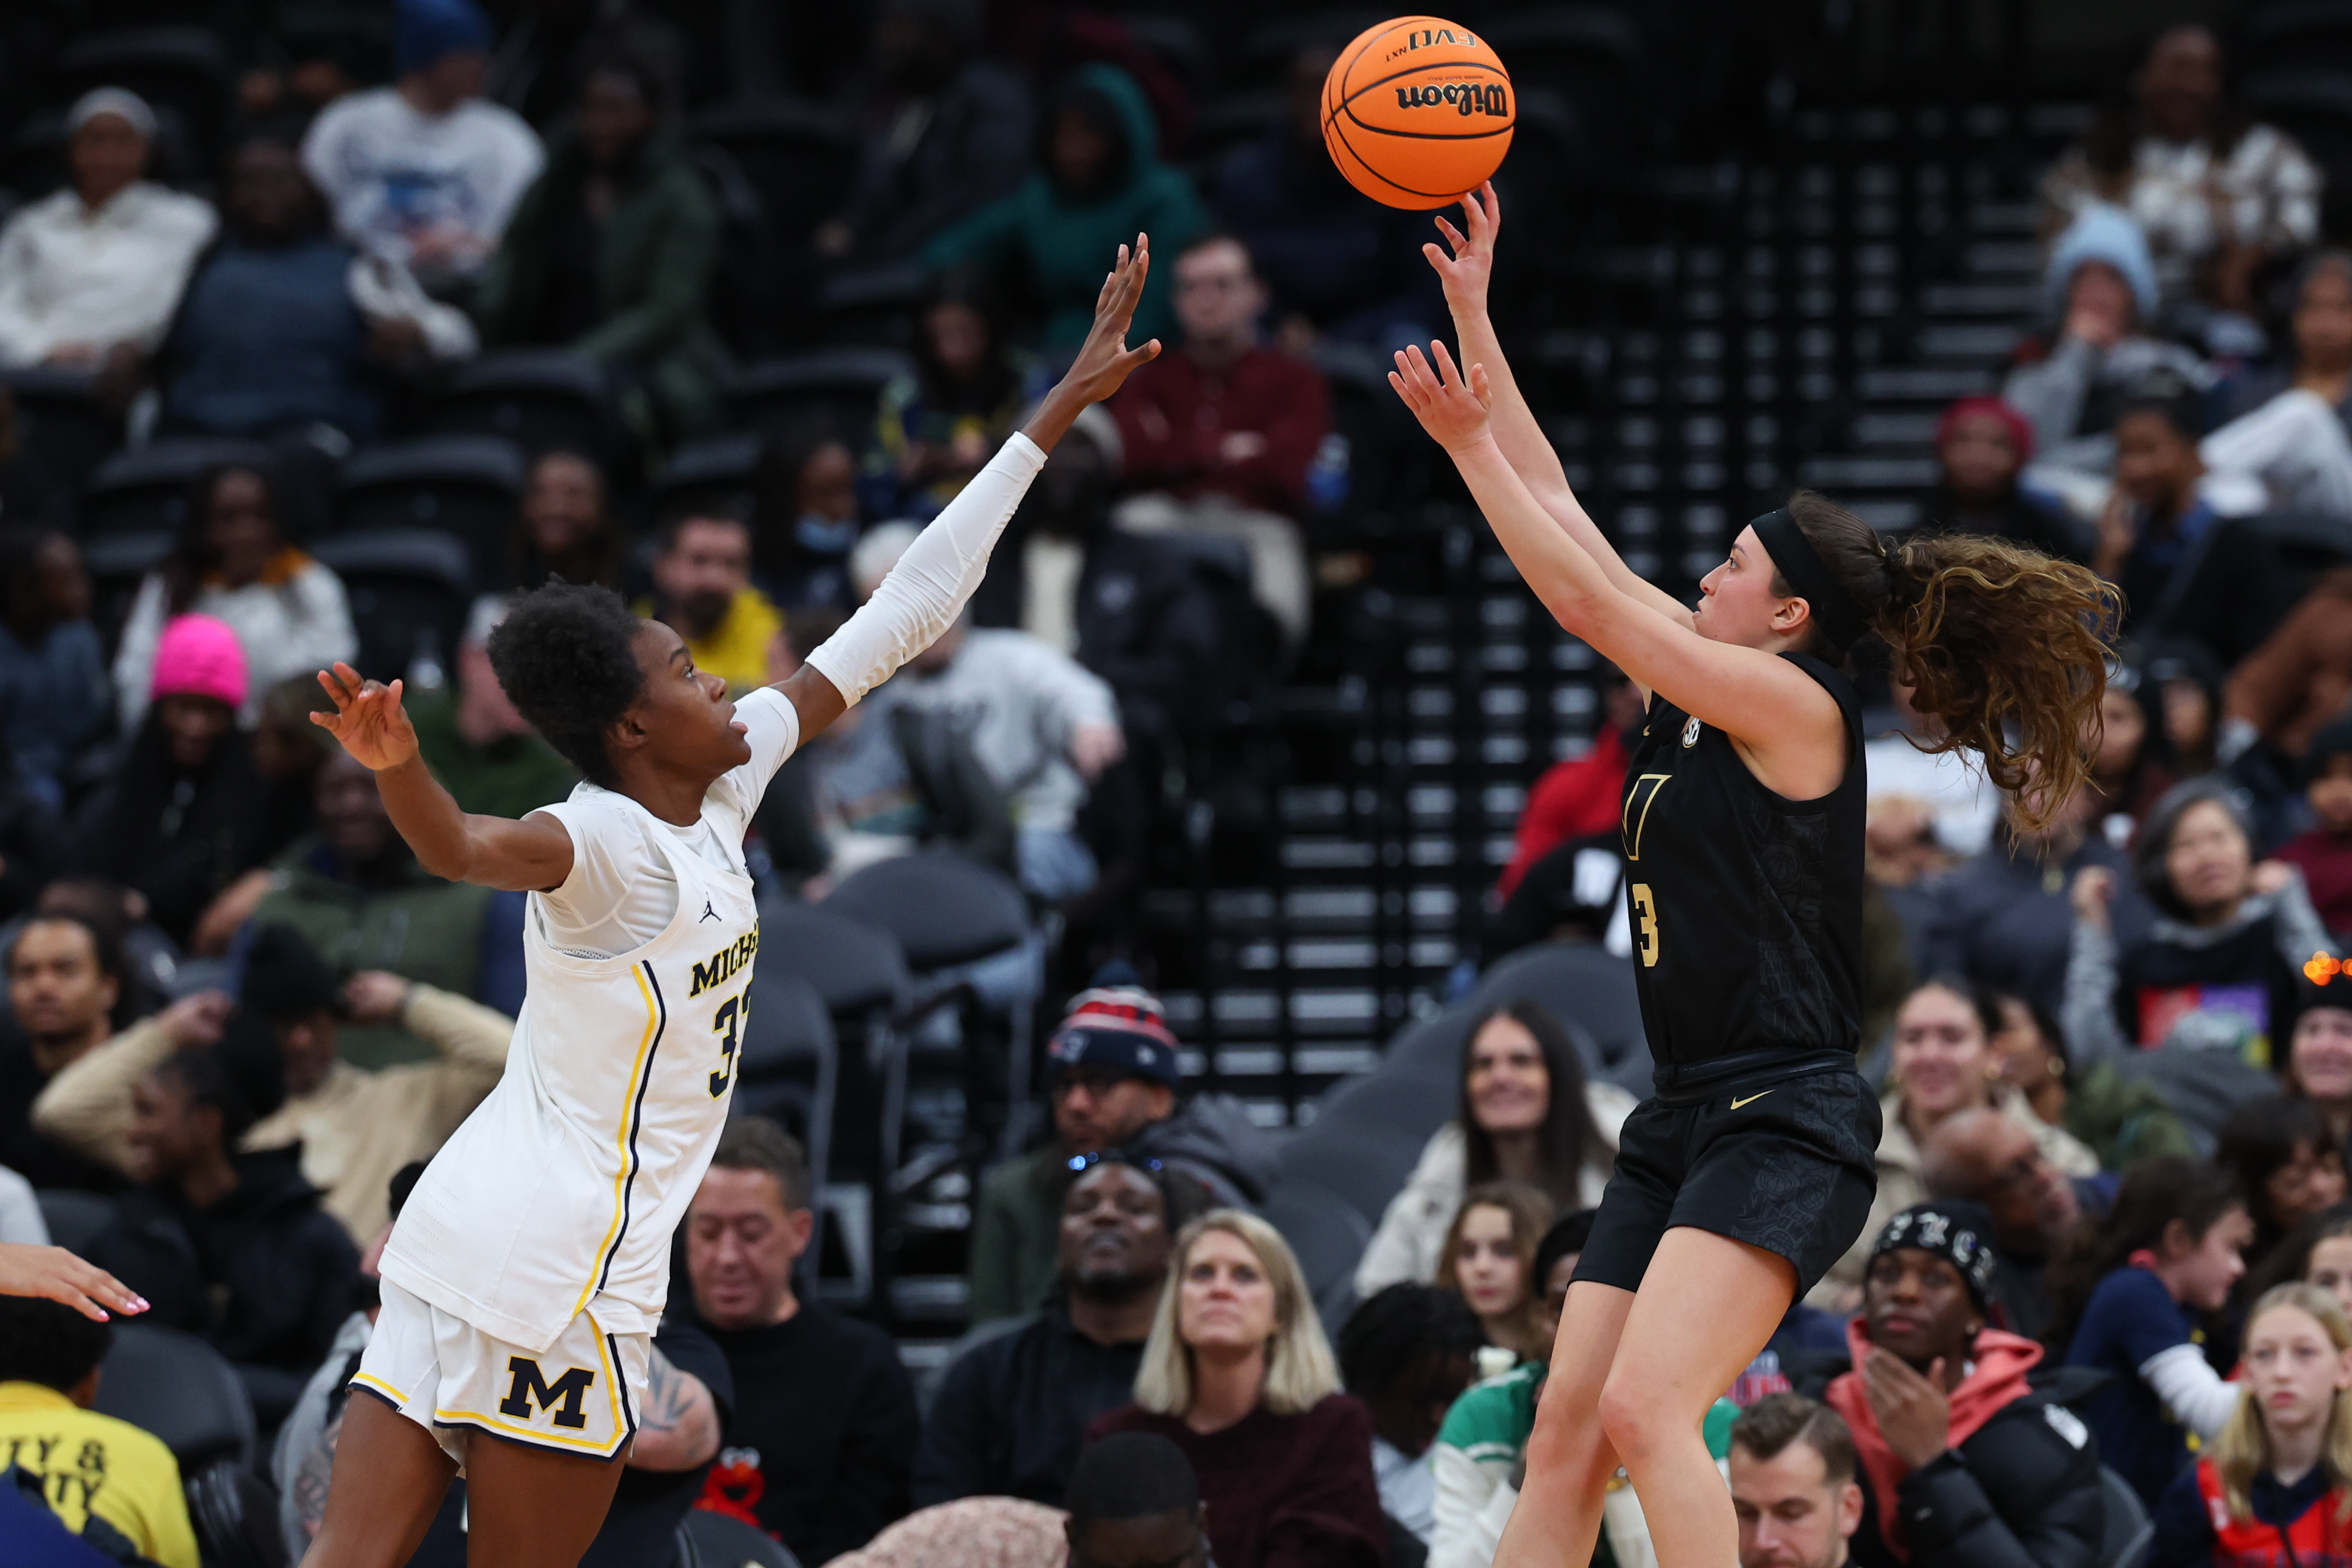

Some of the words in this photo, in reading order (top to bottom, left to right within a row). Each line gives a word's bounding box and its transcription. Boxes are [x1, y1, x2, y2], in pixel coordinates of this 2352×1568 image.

[1409, 29, 1475, 51] EVO
[1395, 83, 1508, 117] Wilson
[1632, 882, 1660, 968] 3
[498, 1355, 596, 1430] M
[77, 1439, 106, 1473] &
